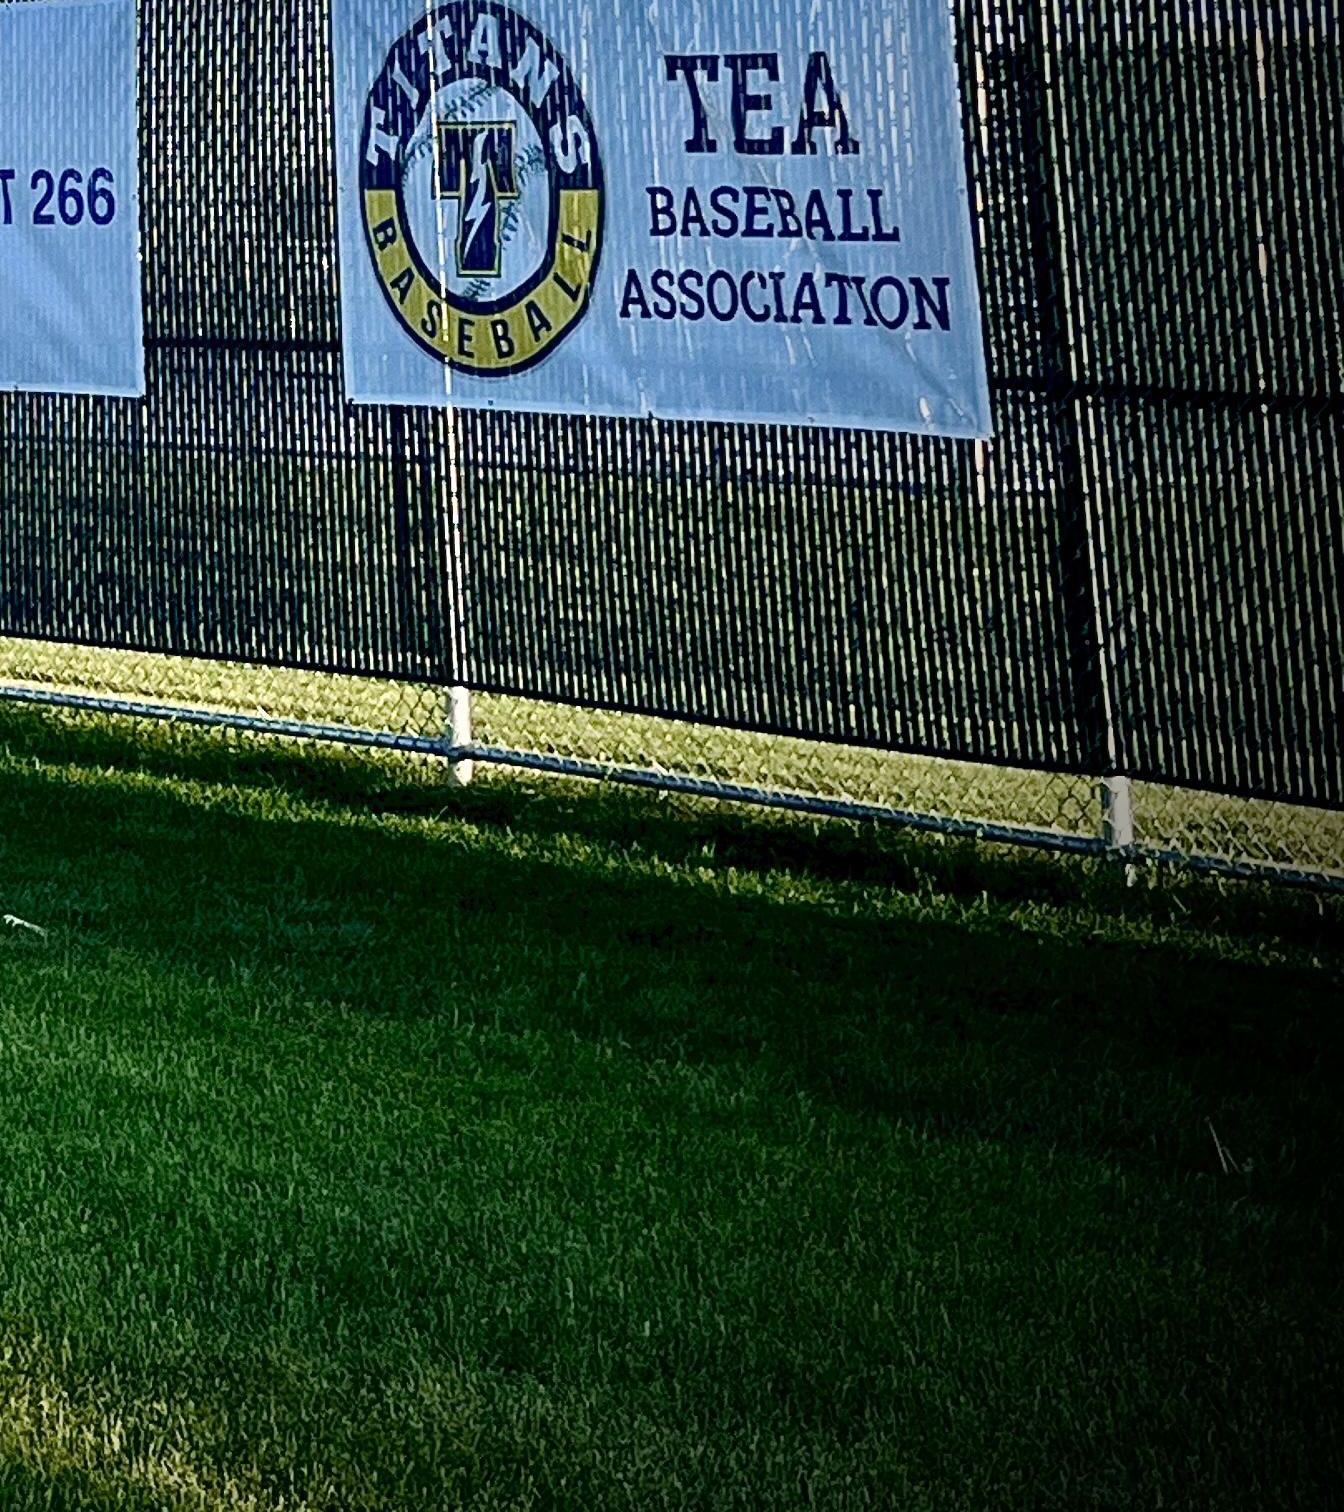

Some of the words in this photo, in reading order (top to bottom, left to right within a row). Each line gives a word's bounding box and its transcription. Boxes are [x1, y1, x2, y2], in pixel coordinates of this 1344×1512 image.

[366, 13, 593, 174] TITANS
[664, 51, 860, 155] TEA
[31, 168, 117, 225] 266
[646, 186, 900, 243] BASEBALL
[373, 216, 593, 360] BASEBALL
[619, 269, 951, 332] ASSOCIATION
